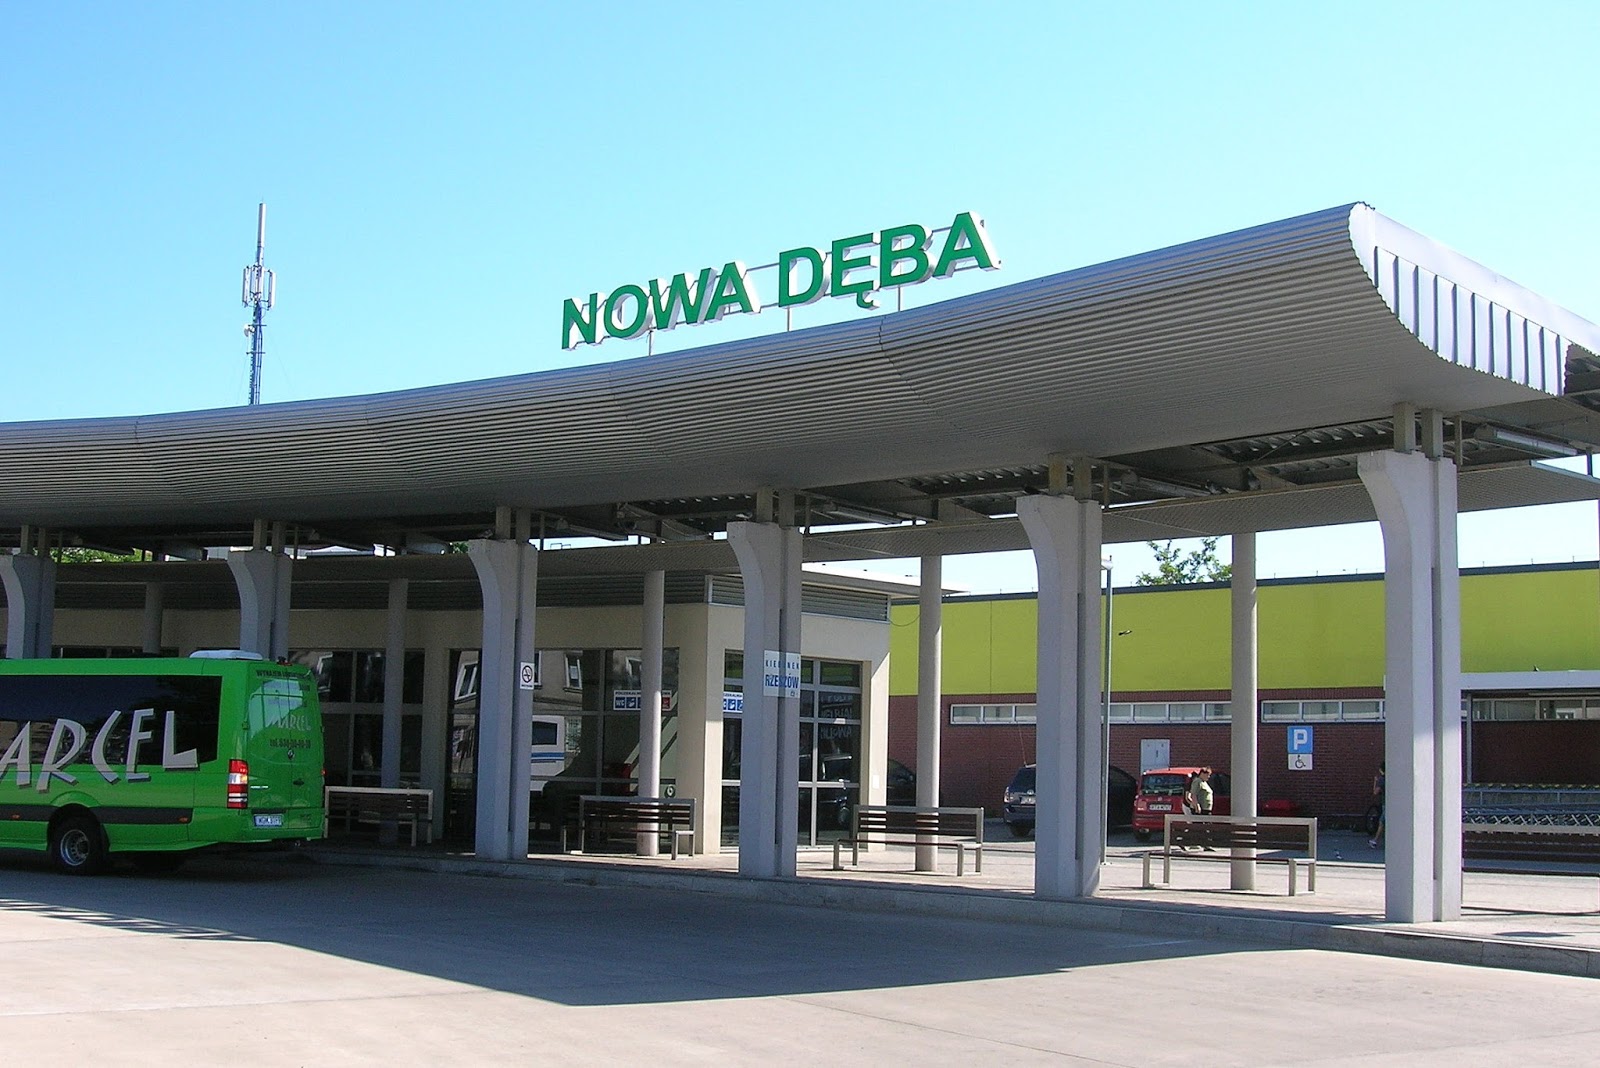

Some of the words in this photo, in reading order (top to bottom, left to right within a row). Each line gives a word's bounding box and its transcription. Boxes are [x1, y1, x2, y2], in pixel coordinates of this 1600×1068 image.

[562, 261, 758, 350] NOWA
[778, 211, 999, 310] DĘBA
[765, 673, 800, 689] RZESZÓW
[1293, 729, 1308, 751] P
